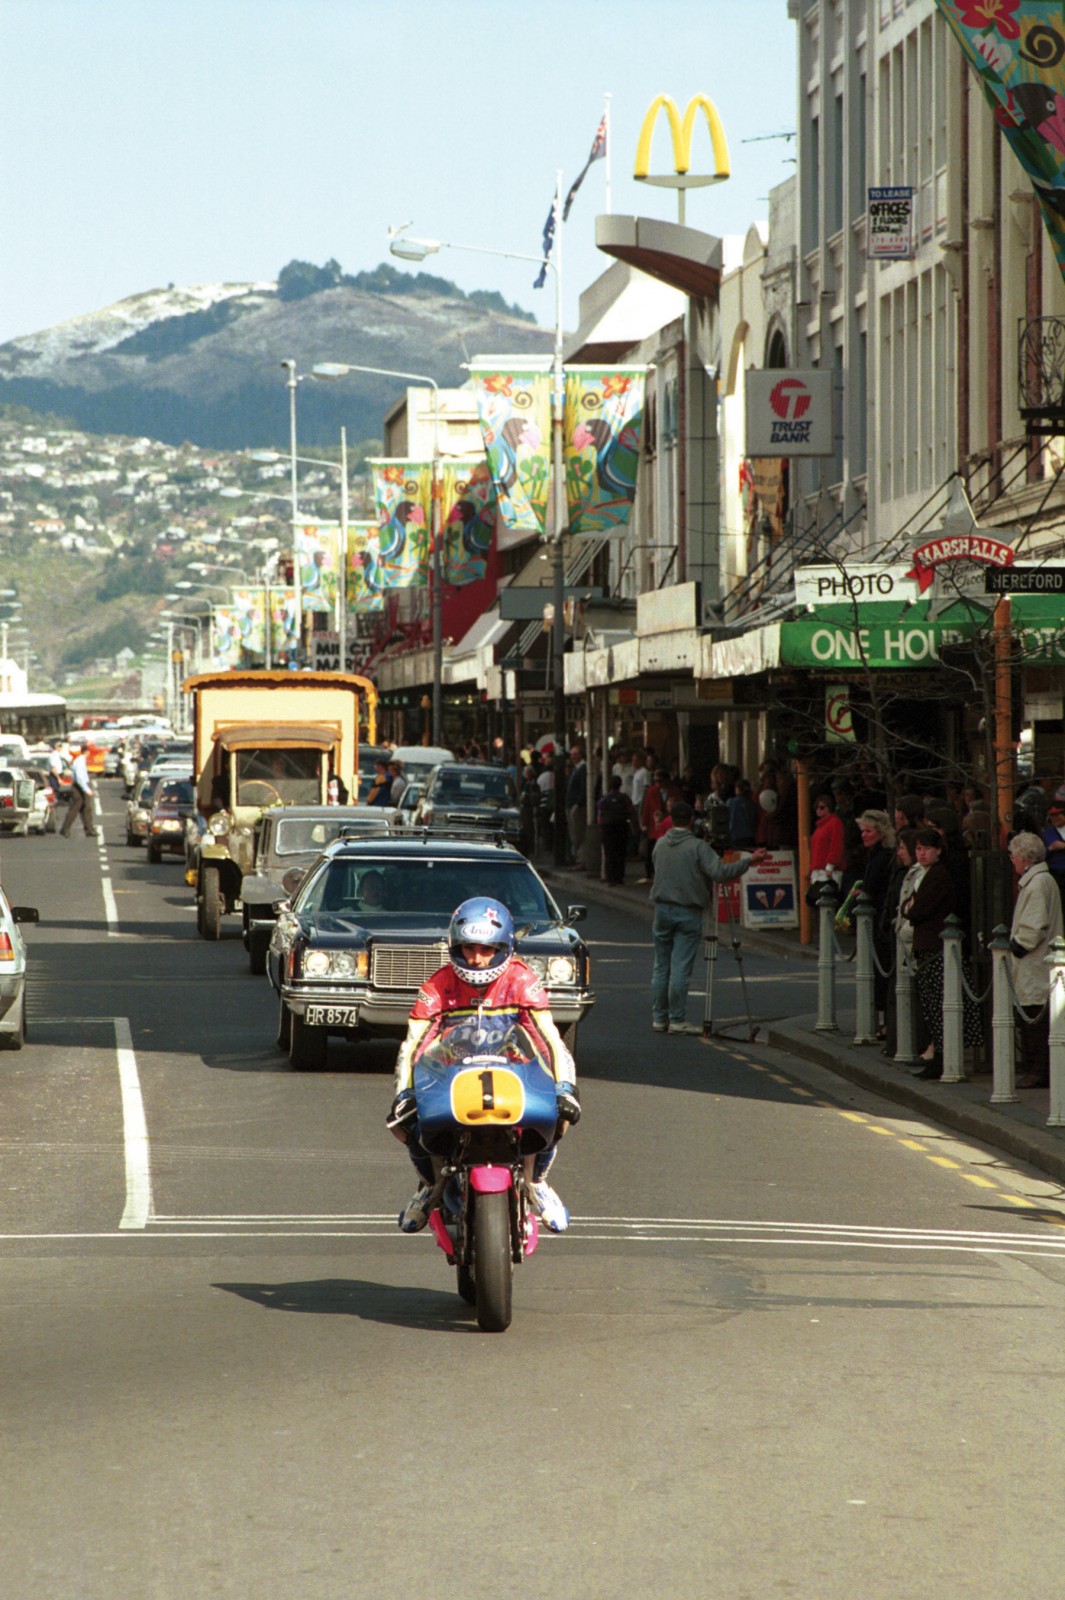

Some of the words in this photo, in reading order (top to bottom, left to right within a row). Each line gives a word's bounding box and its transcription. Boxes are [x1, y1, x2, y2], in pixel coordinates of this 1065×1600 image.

[871, 190, 881, 198] TO
[883, 189, 910, 198] LEASE
[870, 202, 911, 216] OFFICES
[771, 421, 813, 431] TRUST
[770, 432, 811, 443] BANK
[917, 538, 1009, 566] MARSHALLS
[818, 573, 894, 597] PHOTO
[993, 573, 1063, 590] HEREFORD
[811, 629, 870, 661] ONE
[306, 1008, 324, 1024] HR
[327, 1008, 356, 1025] 8574
[478, 1070, 495, 1111] 1
